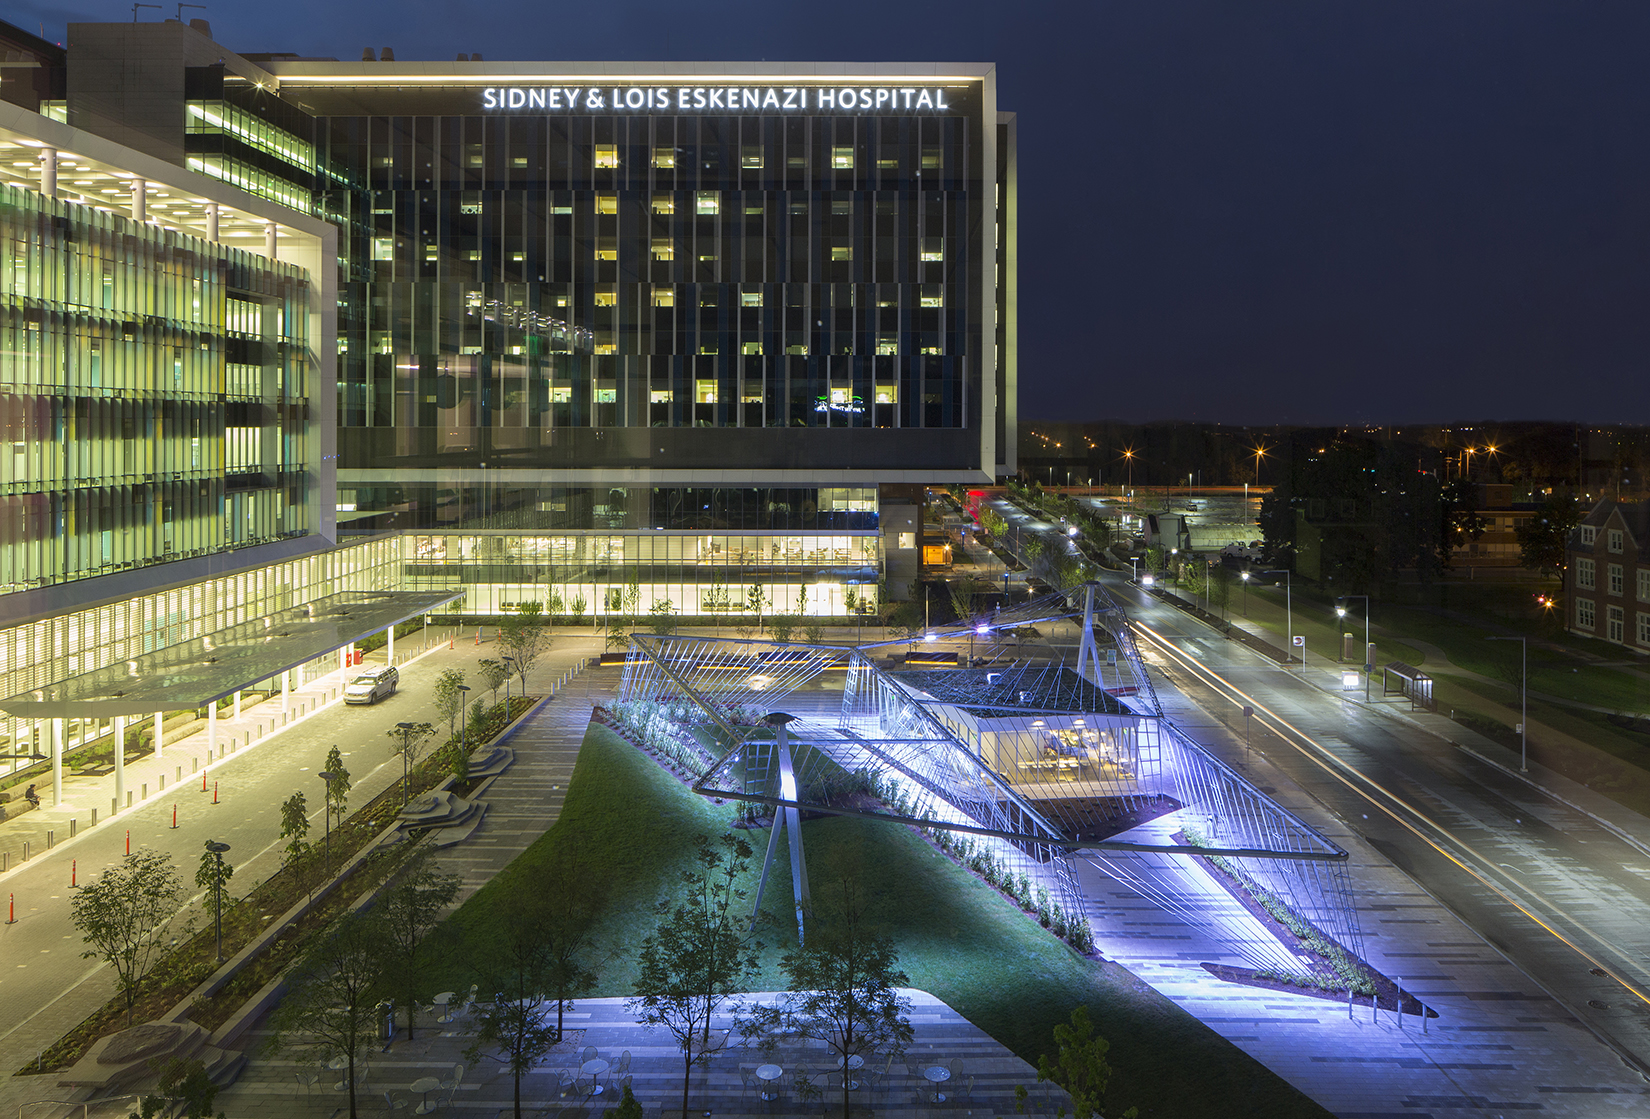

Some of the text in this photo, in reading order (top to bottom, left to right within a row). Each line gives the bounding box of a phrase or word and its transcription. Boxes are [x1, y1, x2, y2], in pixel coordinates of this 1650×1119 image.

[483, 87, 949, 109] SIDNEY & LOIS ESKENAZI HOSPITAL
